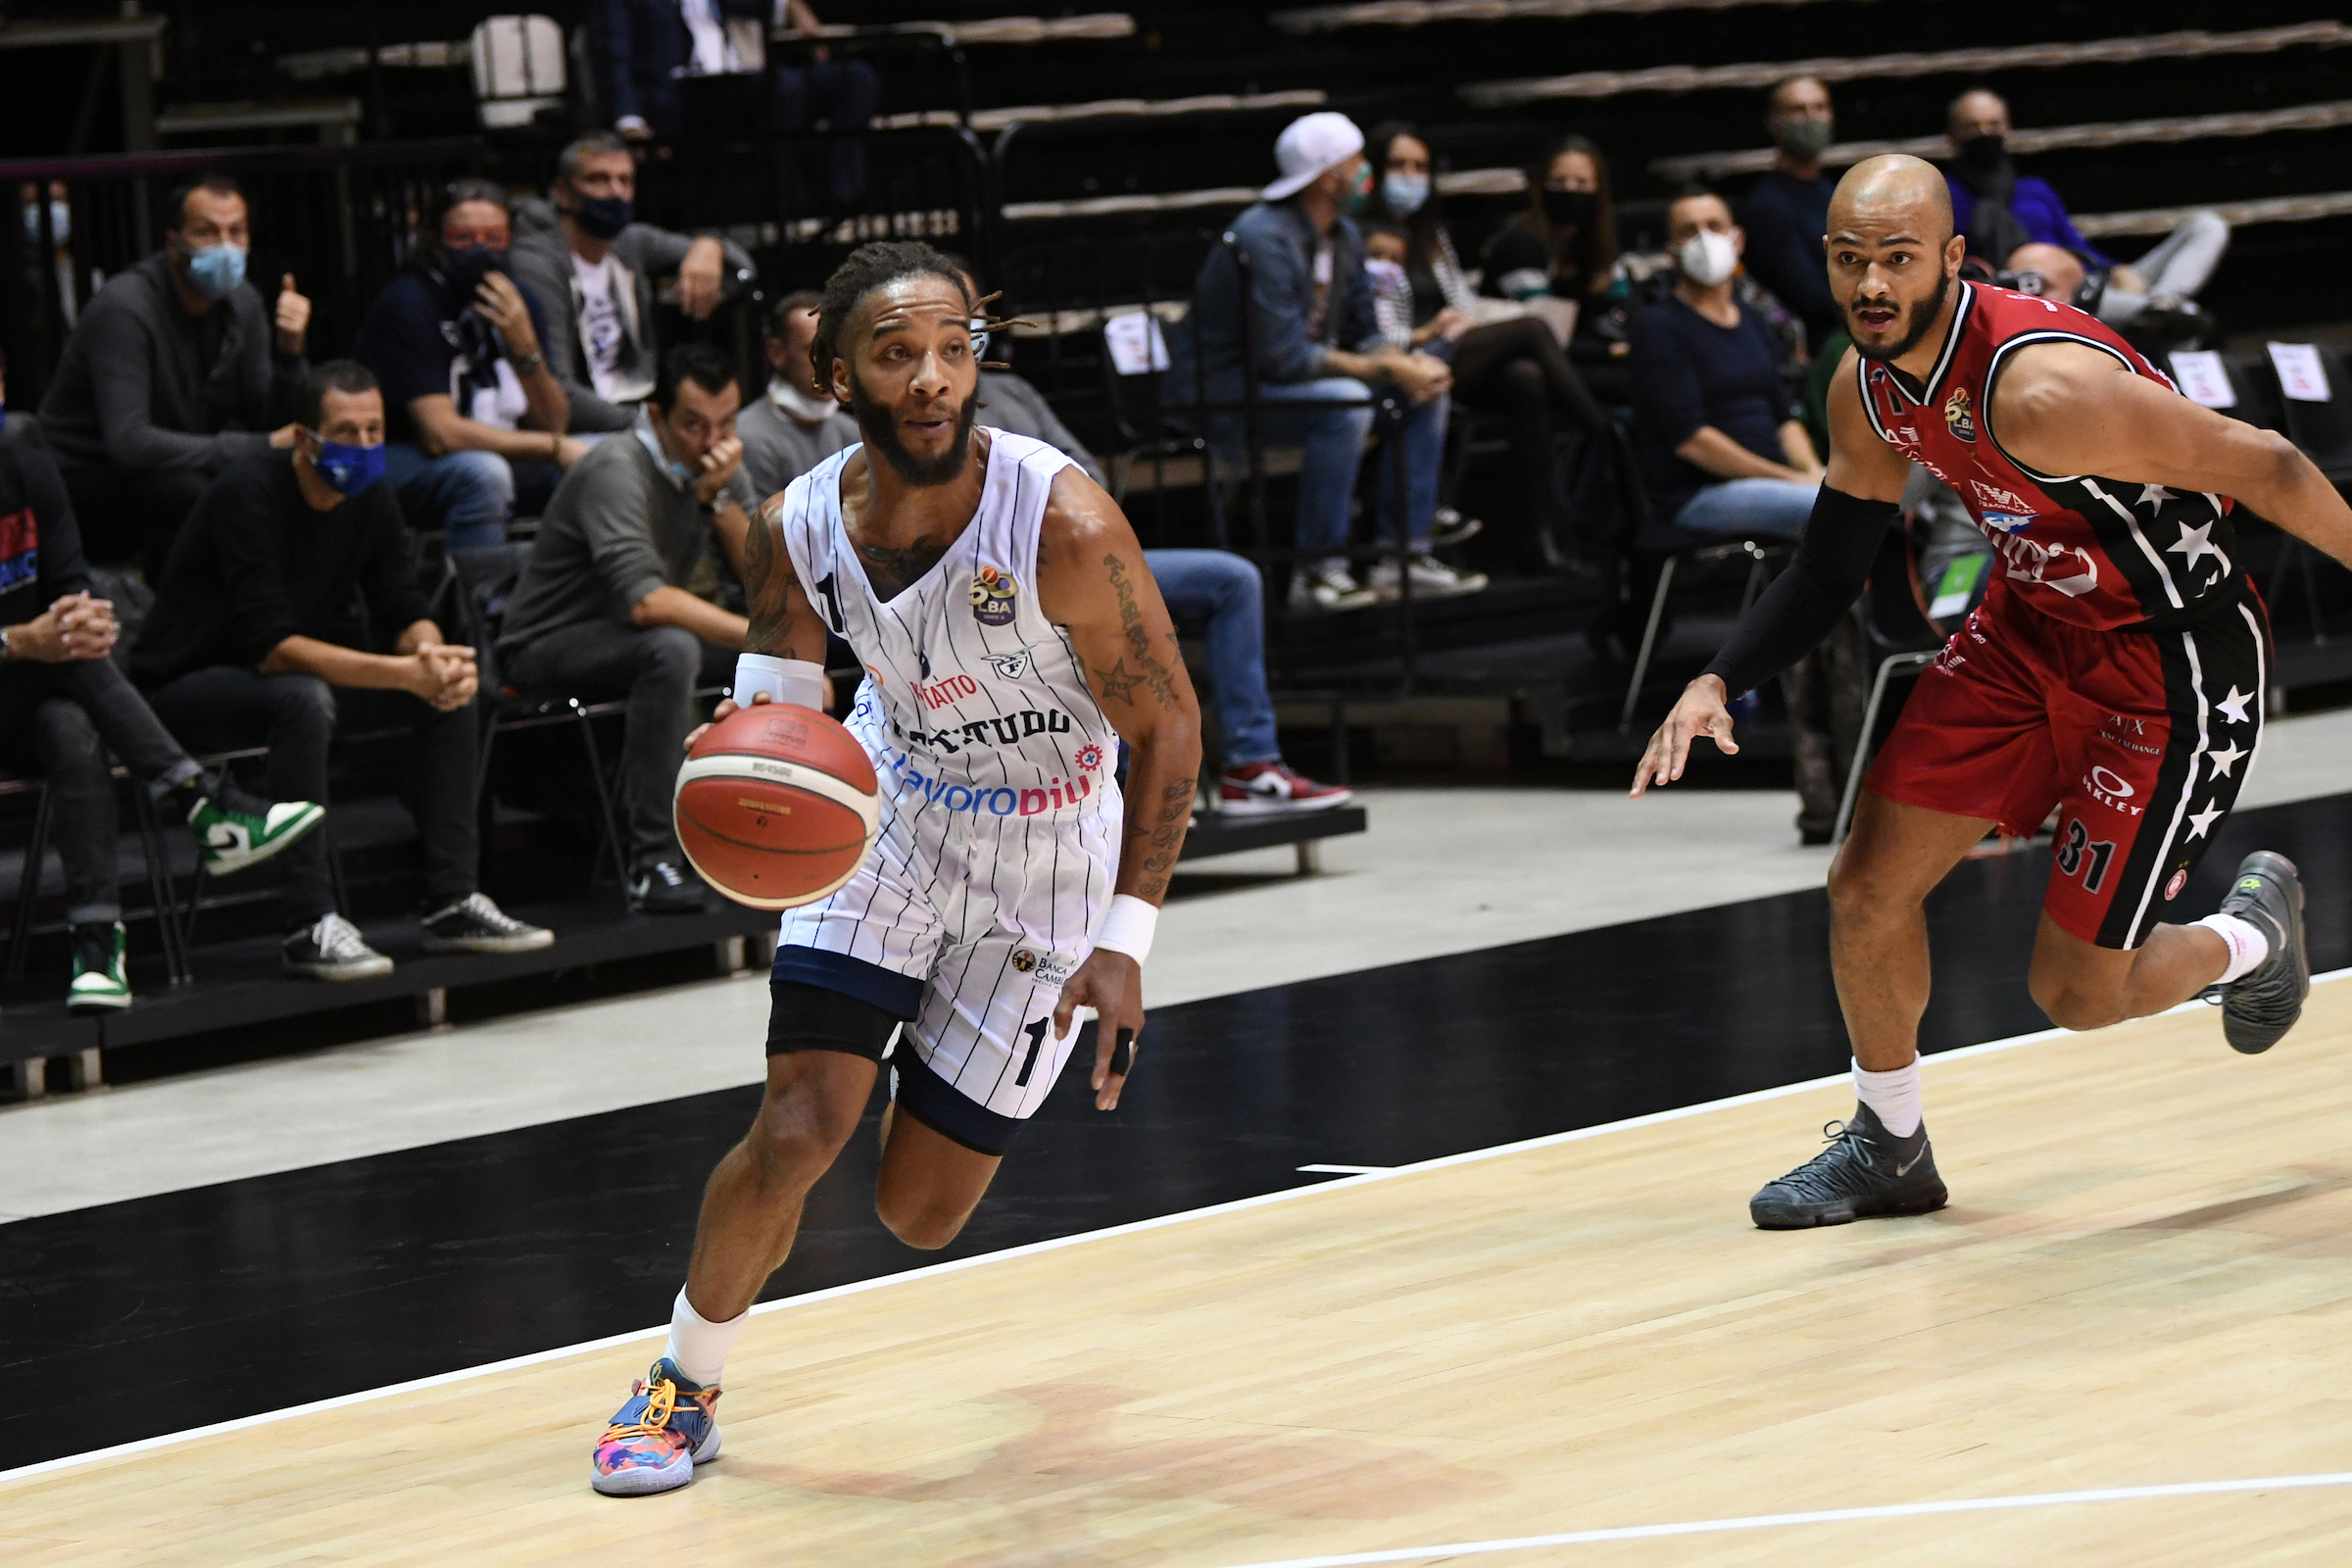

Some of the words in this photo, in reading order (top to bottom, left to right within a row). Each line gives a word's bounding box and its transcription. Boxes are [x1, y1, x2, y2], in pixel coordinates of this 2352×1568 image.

[816, 572, 844, 633] 1
[978, 600, 1011, 613] LBA
[2056, 817, 2117, 895] 31
[1035, 968, 1064, 986] CAMBI
[1038, 957, 1067, 975] BANCA
[1014, 1016, 1050, 1088] 1
